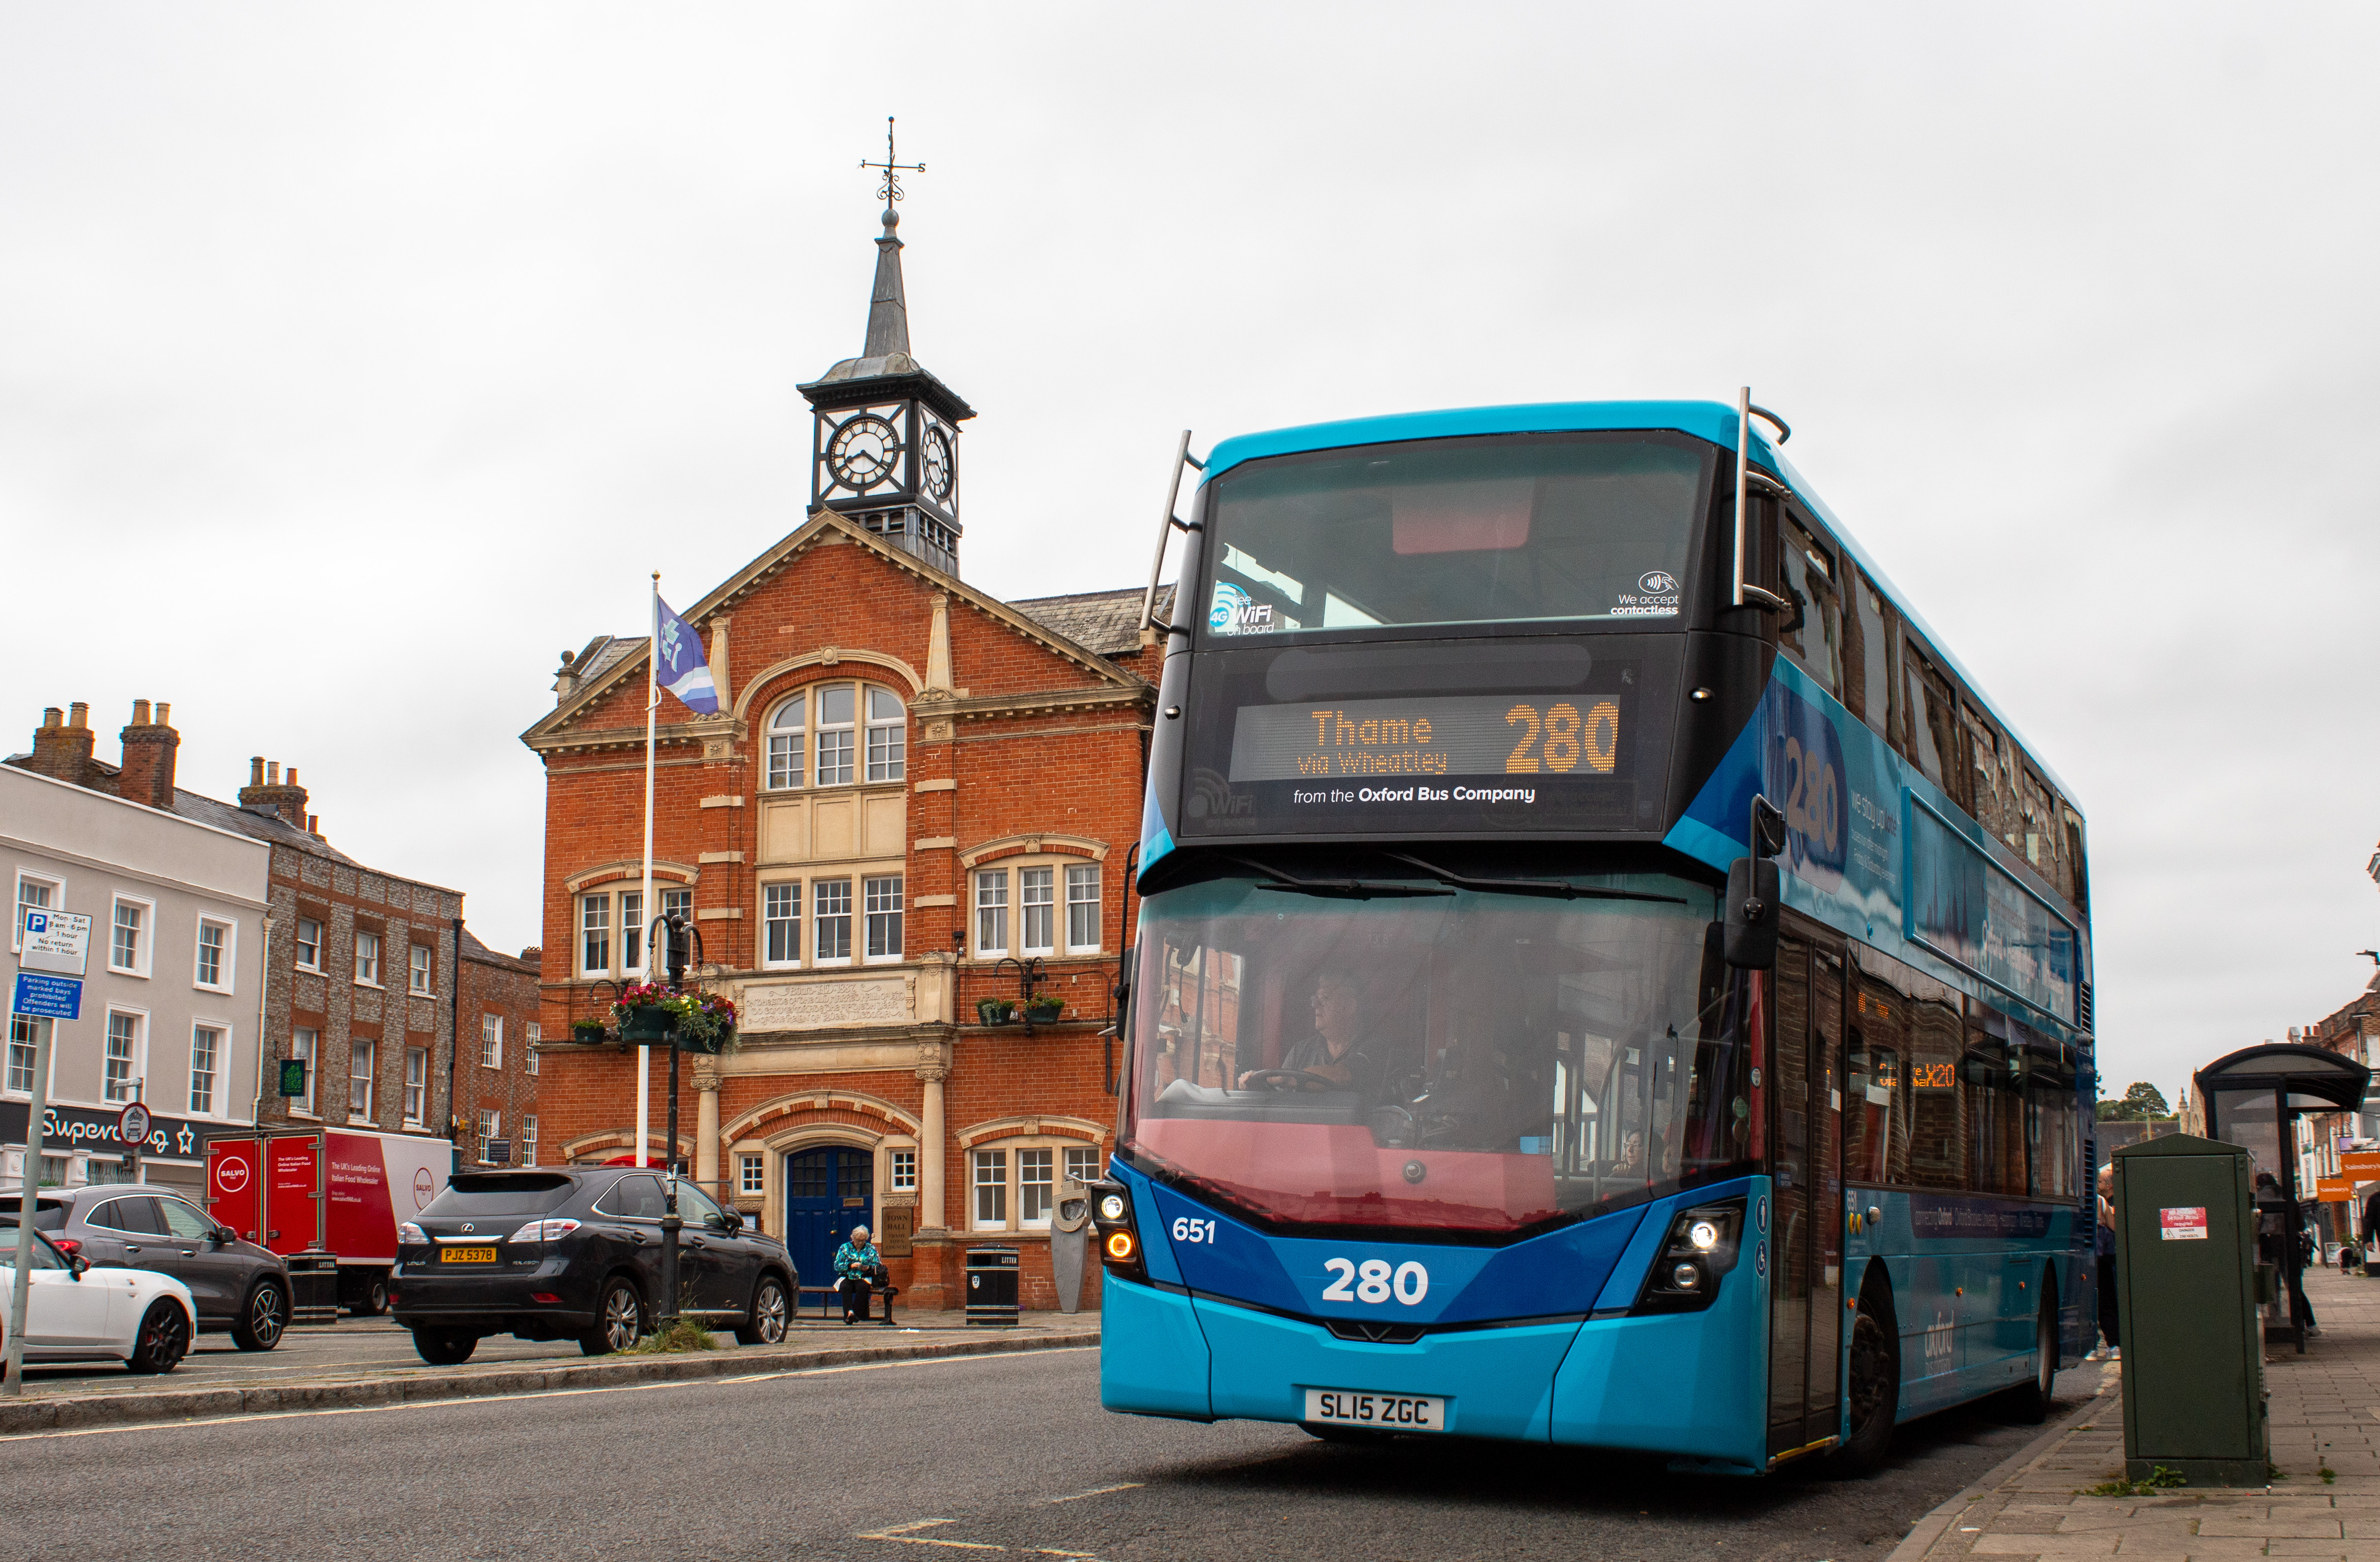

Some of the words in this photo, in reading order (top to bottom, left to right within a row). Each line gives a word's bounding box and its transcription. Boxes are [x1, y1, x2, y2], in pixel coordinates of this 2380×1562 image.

[1618, 594, 1637, 604] We
[1640, 595, 1679, 606] accept
[1210, 611, 1228, 623] 4G
[1232, 604, 1272, 624] WiFi
[1610, 605, 1678, 615] contactless
[1243, 622, 1274, 635] board
[1313, 710, 1432, 746] Thame
[1505, 702, 1619, 773] 280
[1298, 753, 1329, 774] via
[1338, 750, 1447, 775] Wheatley
[1293, 790, 1326, 803] from
[1330, 789, 1354, 802] the
[1358, 788, 1413, 802] Oxford
[1418, 787, 1449, 801] Bus
[1453, 786, 1535, 803] Company
[1786, 736, 1838, 853] 280
[22, 976, 50, 986] Parking
[22, 998, 58, 1007] Offenders
[30, 993, 66, 1001] prohibited
[31, 1007, 72, 1016] prosecuted
[331, 1162, 340, 1170] The
[351, 1164, 366, 1174] Leading
[356, 1176, 378, 1185] Wholesaler
[416, 1184, 431, 1192] SALVO
[1847, 1190, 1857, 1211] 651
[1172, 1216, 1216, 1244] 651
[445, 1250, 464, 1260] PJZ
[467, 1250, 493, 1261] 5378
[1322, 1258, 1428, 1306] 280
[1320, 1394, 1374, 1420] SL15
[1381, 1398, 1429, 1424] ZGC
